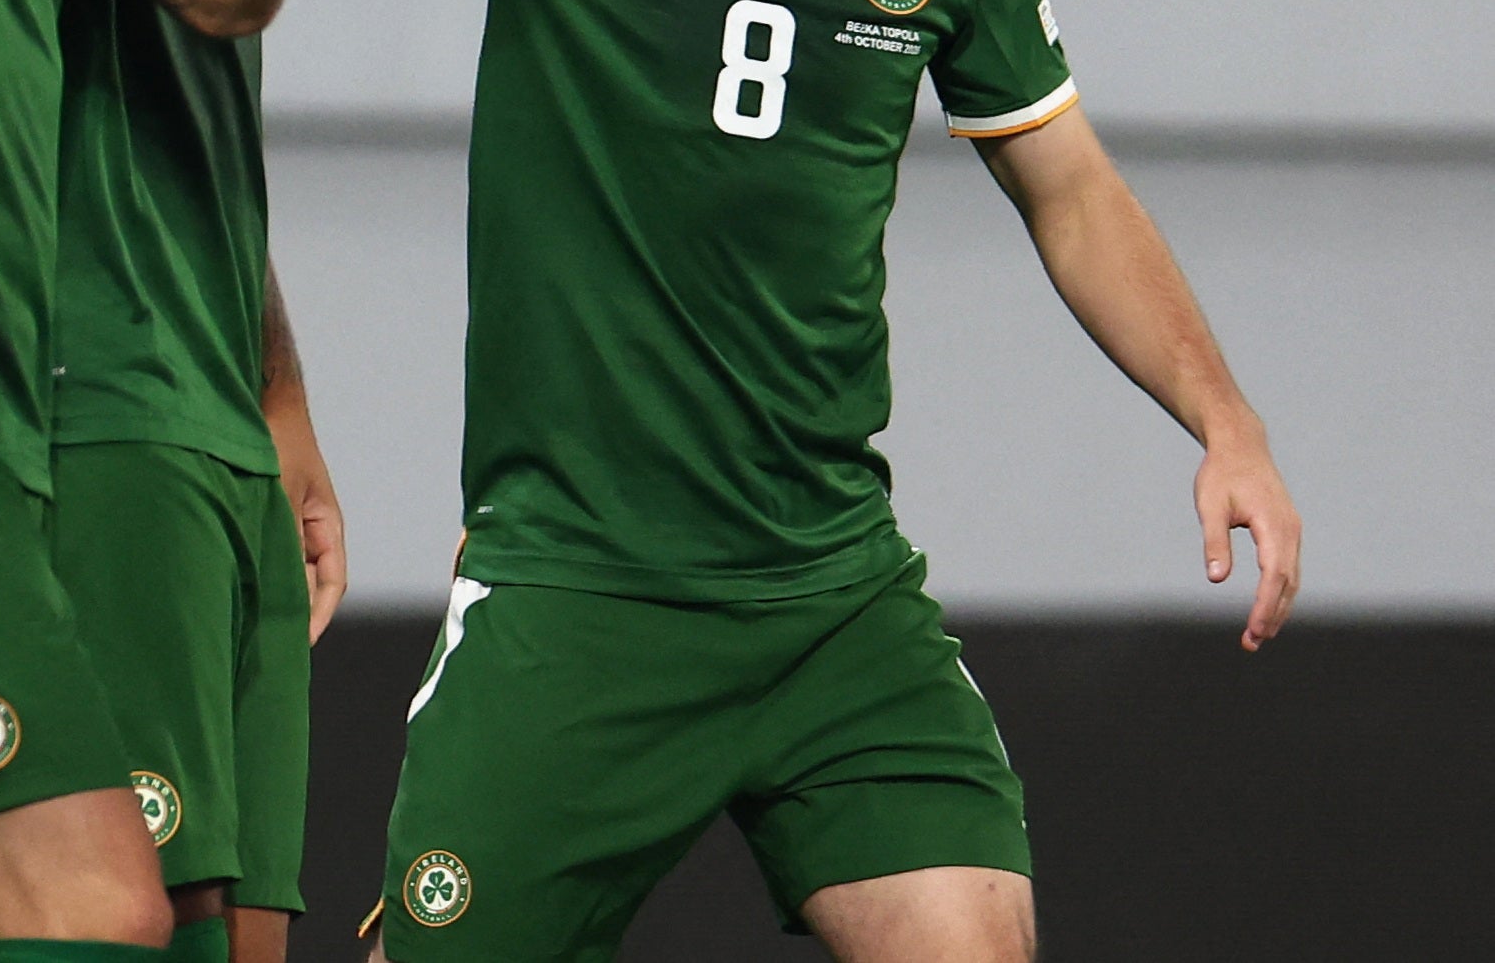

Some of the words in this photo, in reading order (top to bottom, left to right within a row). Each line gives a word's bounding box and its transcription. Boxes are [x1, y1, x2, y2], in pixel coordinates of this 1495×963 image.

[834, 32, 853, 44] 4th
[854, 36, 903, 53] OCTOBER
[881, 26, 920, 42] TOPOLA
[712, 0, 796, 140] 8
[416, 855, 468, 885] IRELAND
